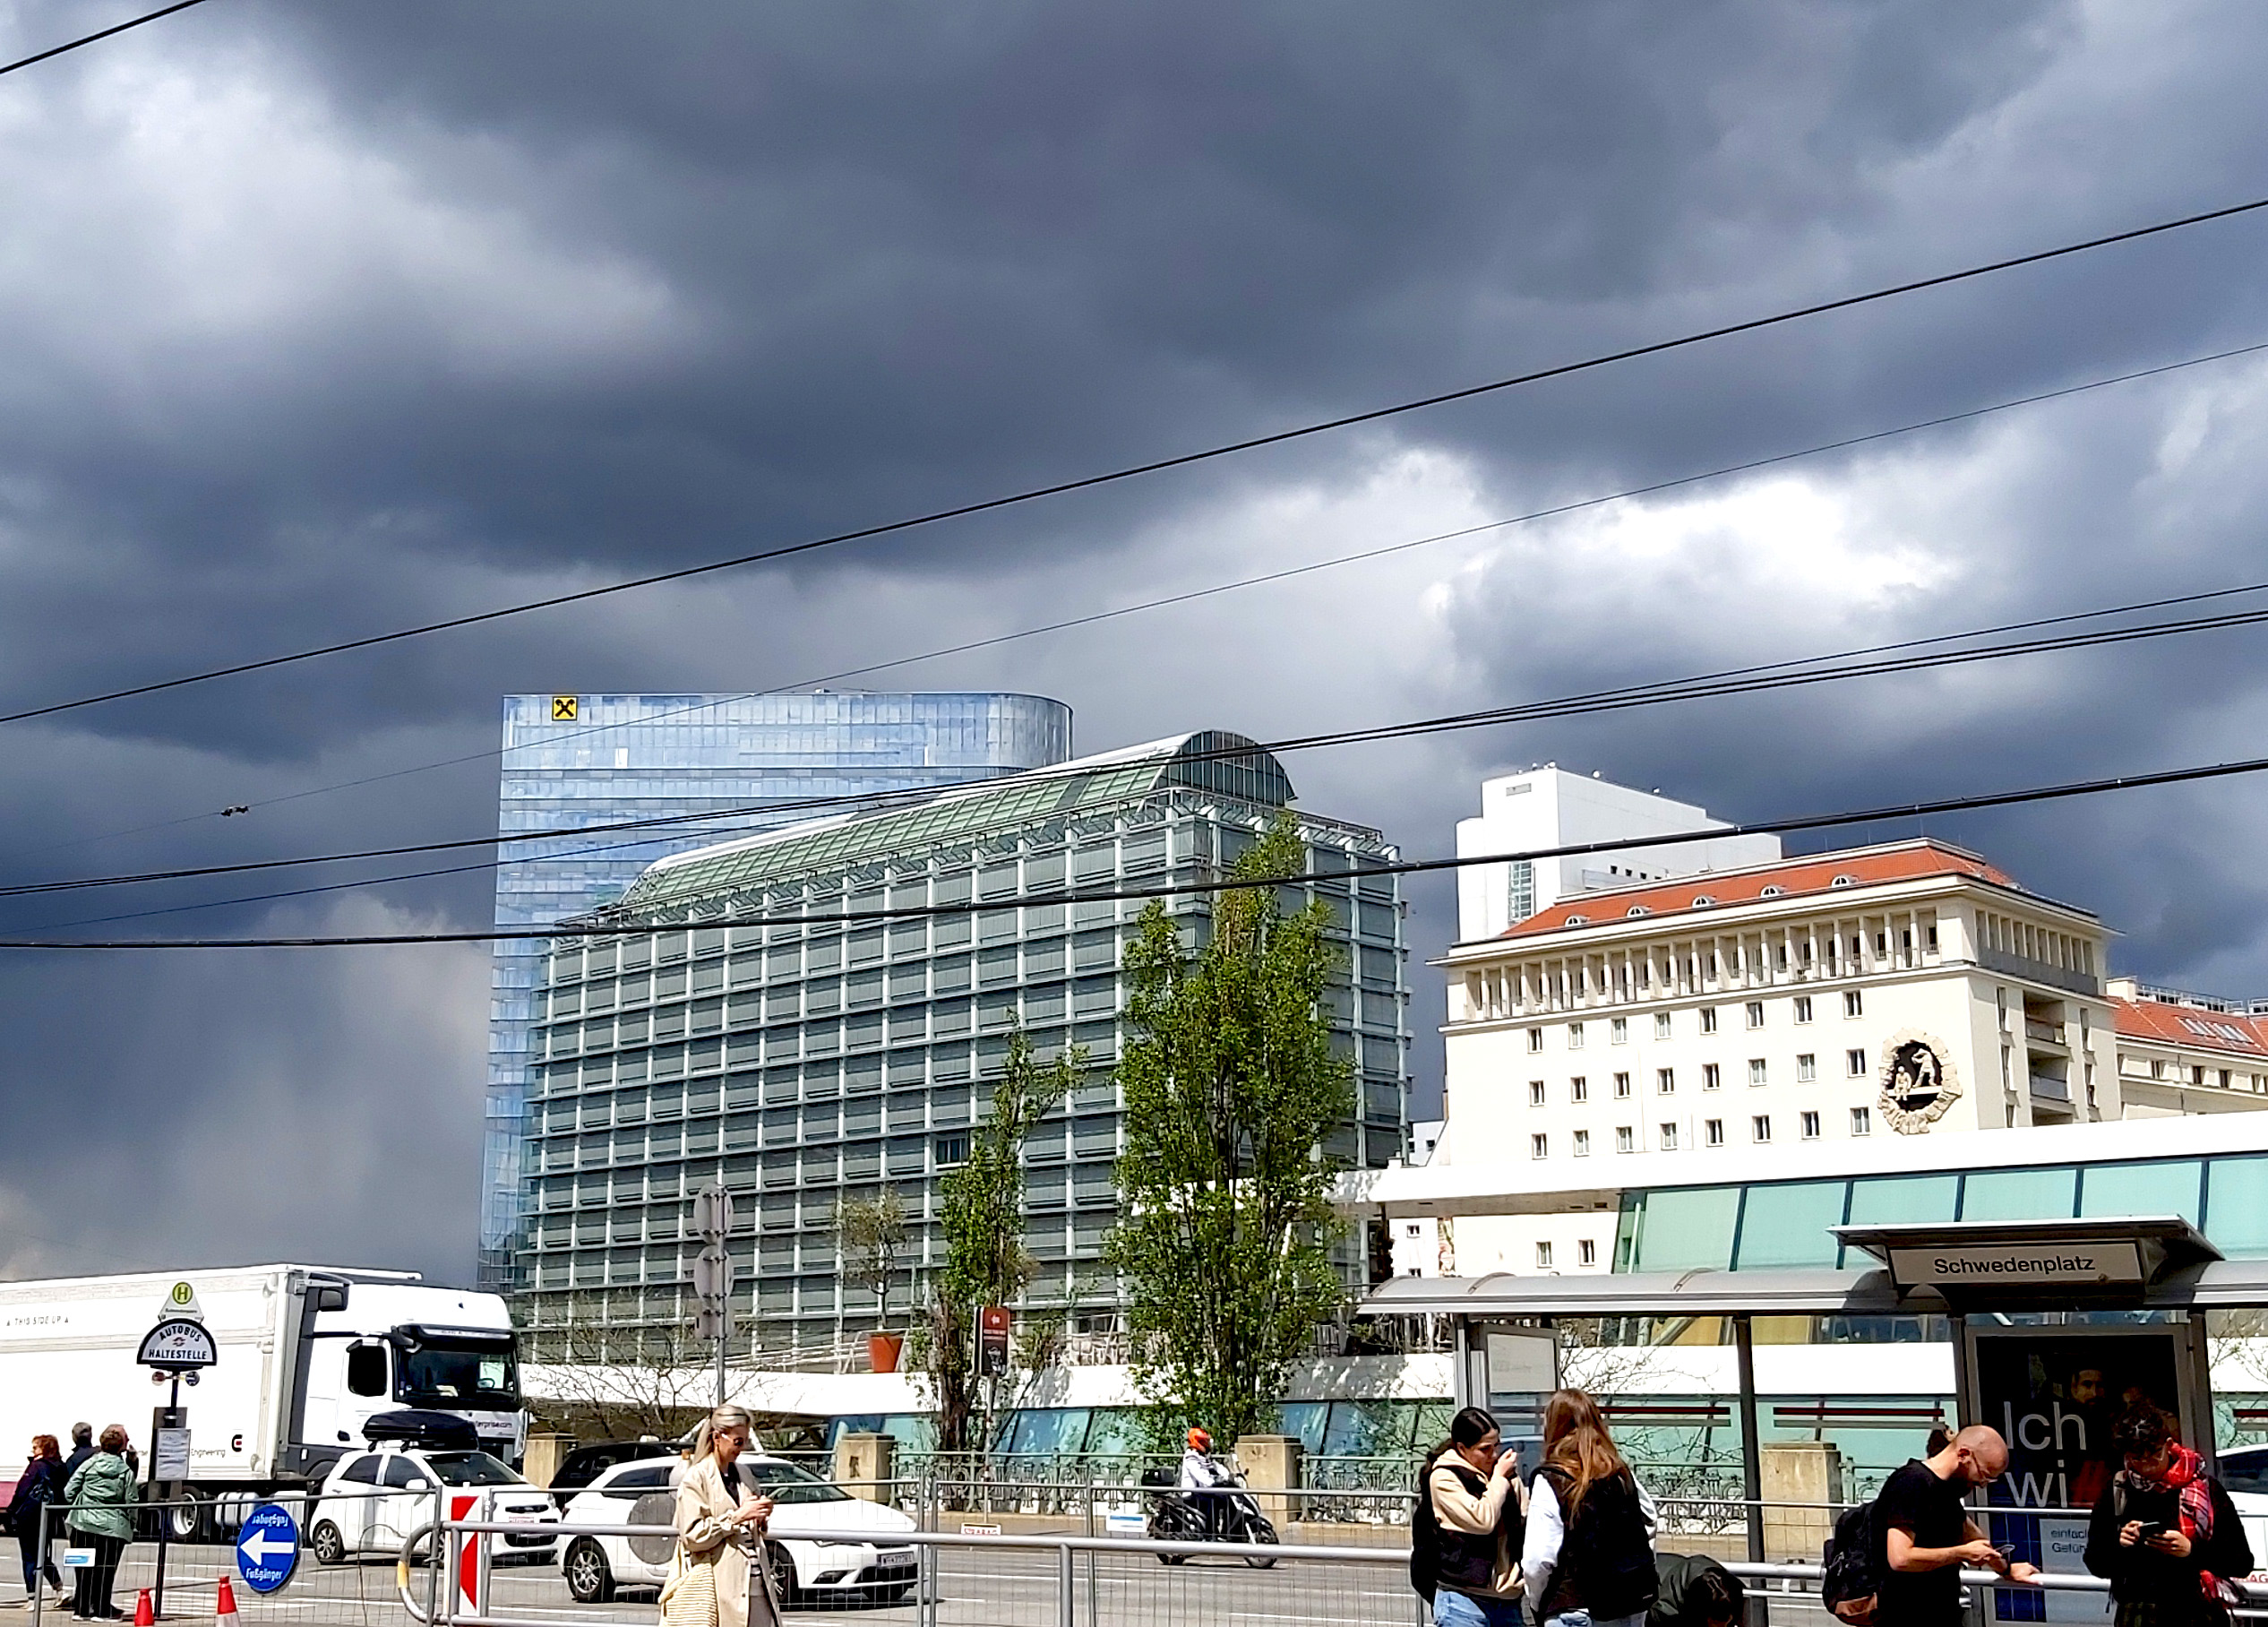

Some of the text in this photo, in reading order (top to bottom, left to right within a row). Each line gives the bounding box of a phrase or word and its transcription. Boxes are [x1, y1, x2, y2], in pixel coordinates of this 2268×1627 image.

[1934, 1256, 2095, 1275] Schwedenplatz
[177, 1287, 188, 1300] H
[159, 1325, 202, 1342] AUTOBUS
[149, 1348, 207, 1360] HALTESTELLE
[2004, 1401, 2086, 1451] Ich
[245, 1567, 284, 1582] Fußgänger
